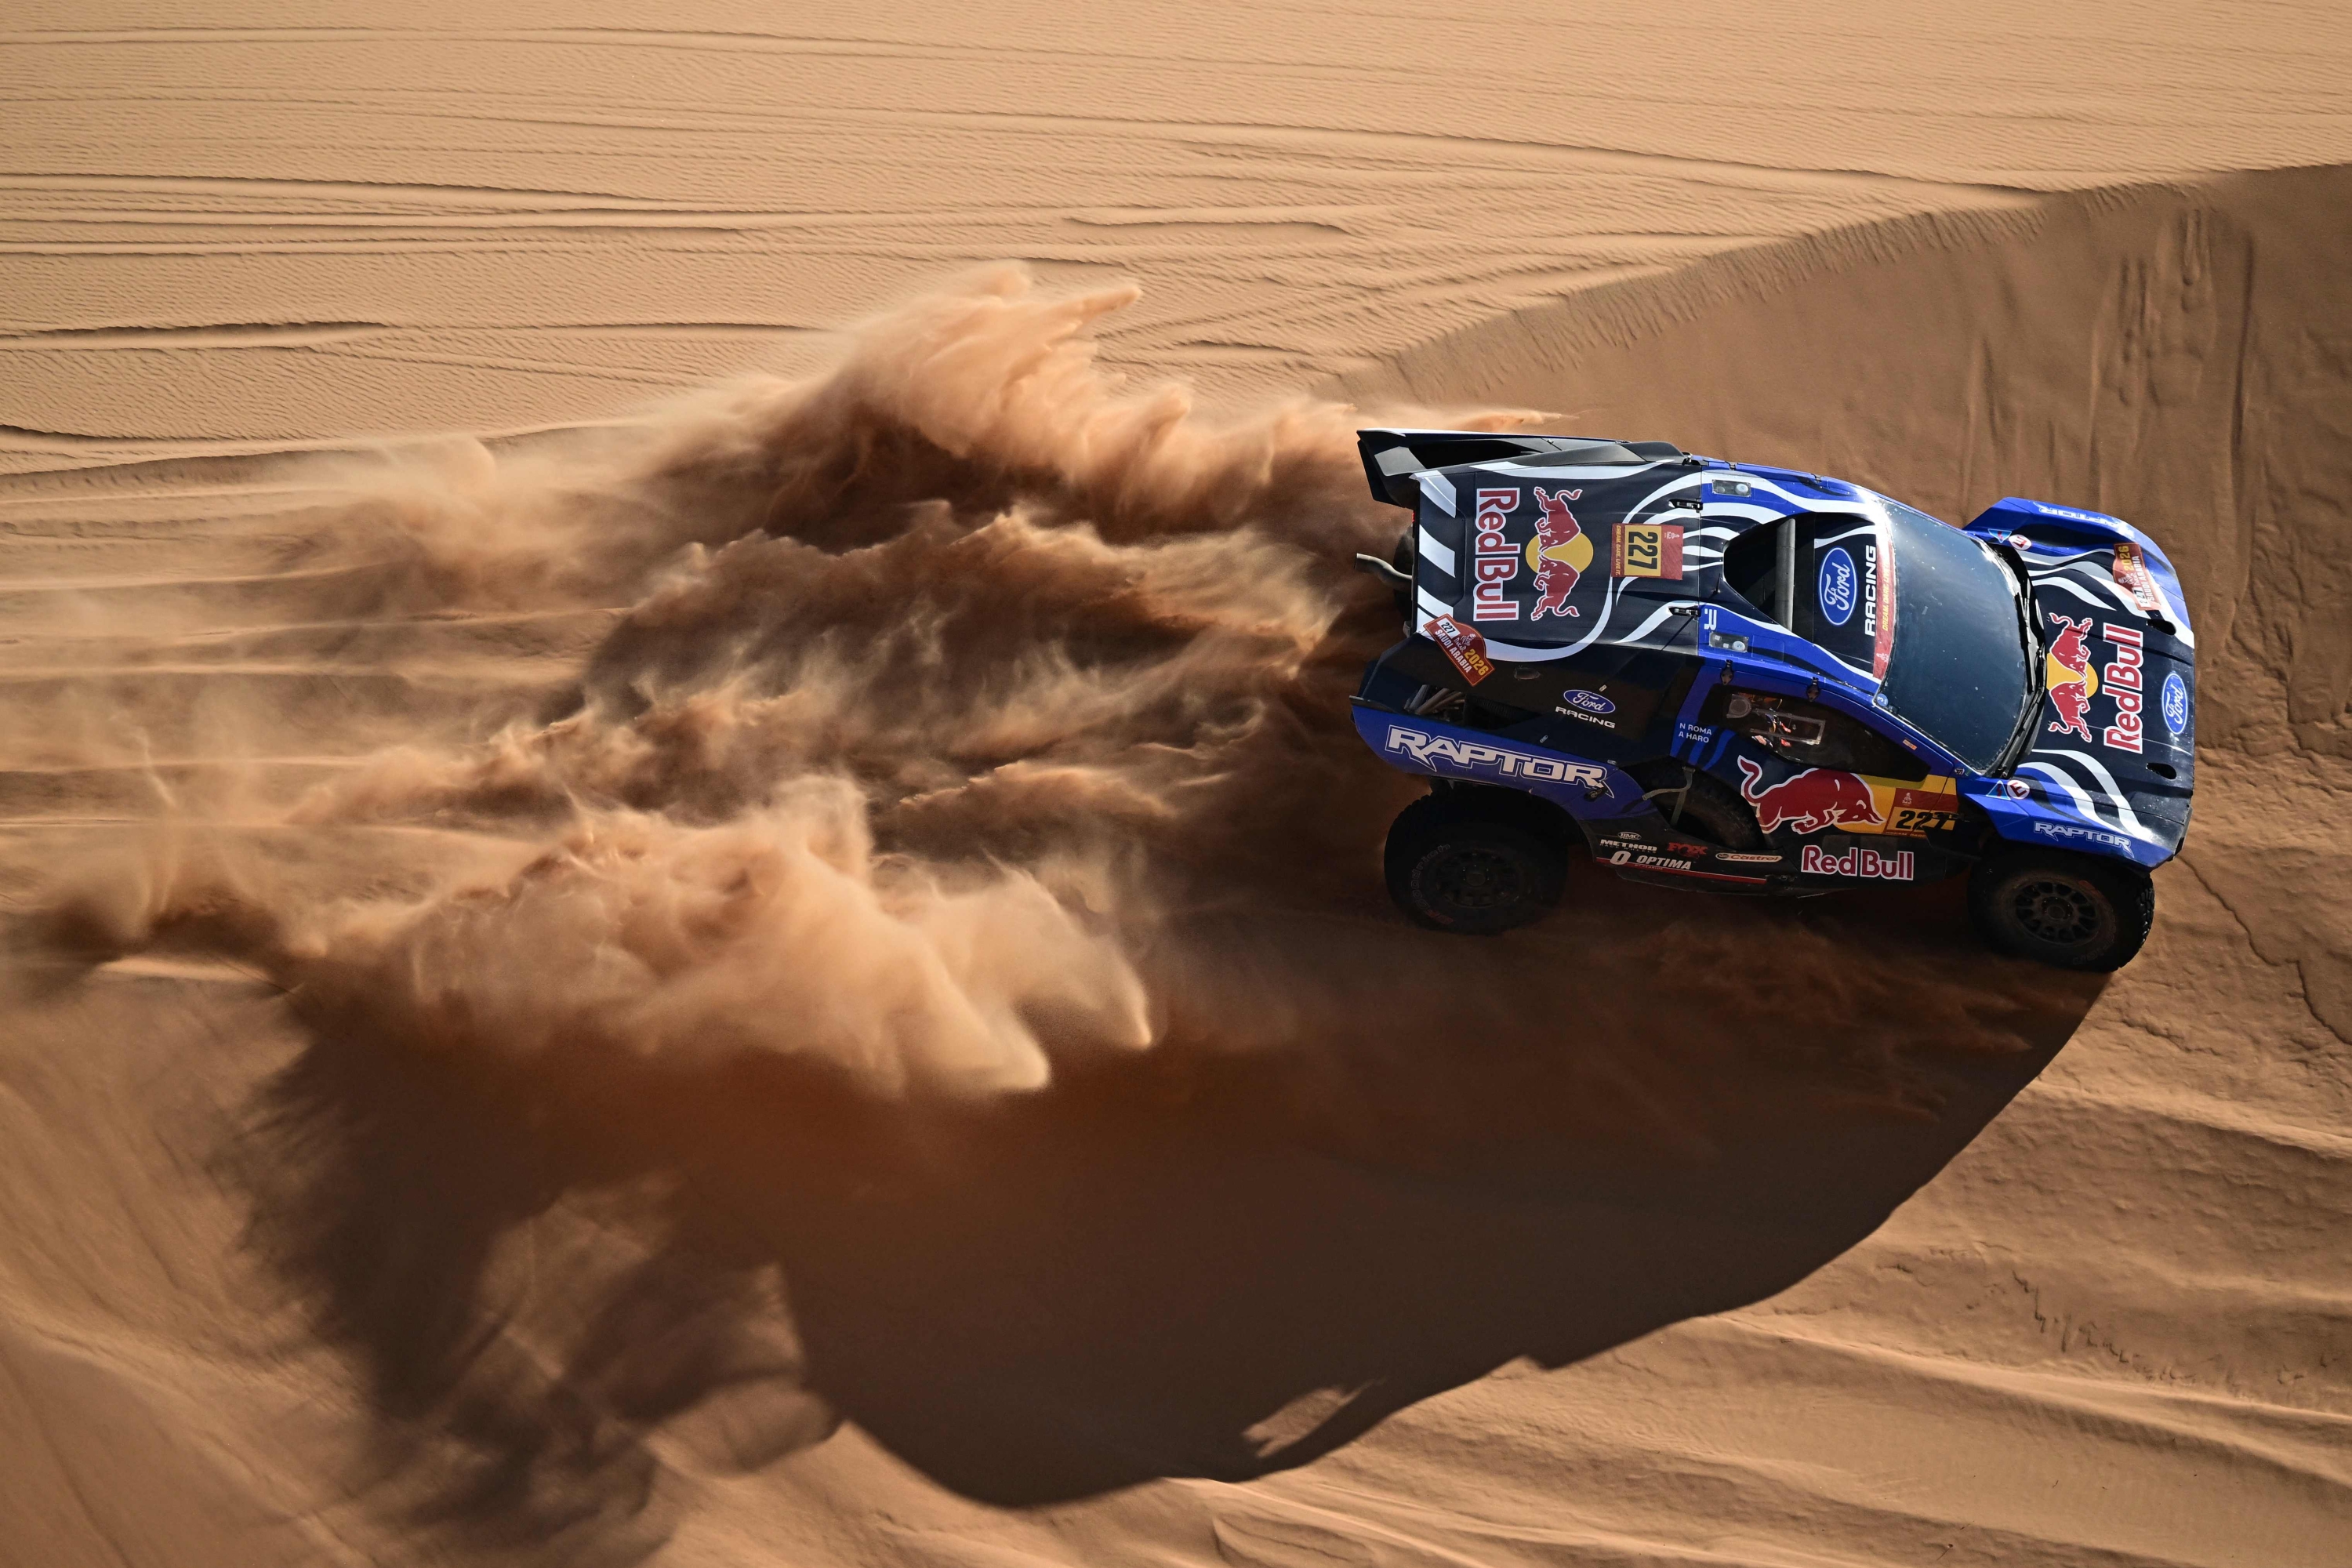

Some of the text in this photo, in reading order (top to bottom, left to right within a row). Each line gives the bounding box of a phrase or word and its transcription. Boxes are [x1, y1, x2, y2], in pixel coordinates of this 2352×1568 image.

[1474, 488, 1519, 620] Red Bull
[1628, 531, 1658, 570] 227
[2118, 545, 2134, 571] 2026
[1824, 561, 1851, 611] Ford
[1864, 545, 1876, 637] RACING
[2132, 555, 2155, 601] SAUDI ARABIA
[1441, 622, 1456, 633] 227
[1435, 629, 1472, 673] SAUDI ARABIA
[1464, 648, 1490, 676] 2026
[1573, 691, 1606, 711] Ford
[2103, 623, 2143, 753] Red Bull
[1555, 706, 1616, 729] RACING
[2165, 684, 2183, 725] Ford
[1686, 732, 1710, 743] HARO
[1688, 724, 1712, 735] ROMA
[1385, 725, 1612, 793] RAPTOR
[1895, 810, 1951, 830] 227
[1599, 839, 1658, 851] METHOD
[1667, 842, 1708, 856] FOX
[2034, 821, 2135, 858] RAPTOR
[1635, 855, 1692, 870] OPTIMA
[1802, 845, 1914, 880] Red Bull
